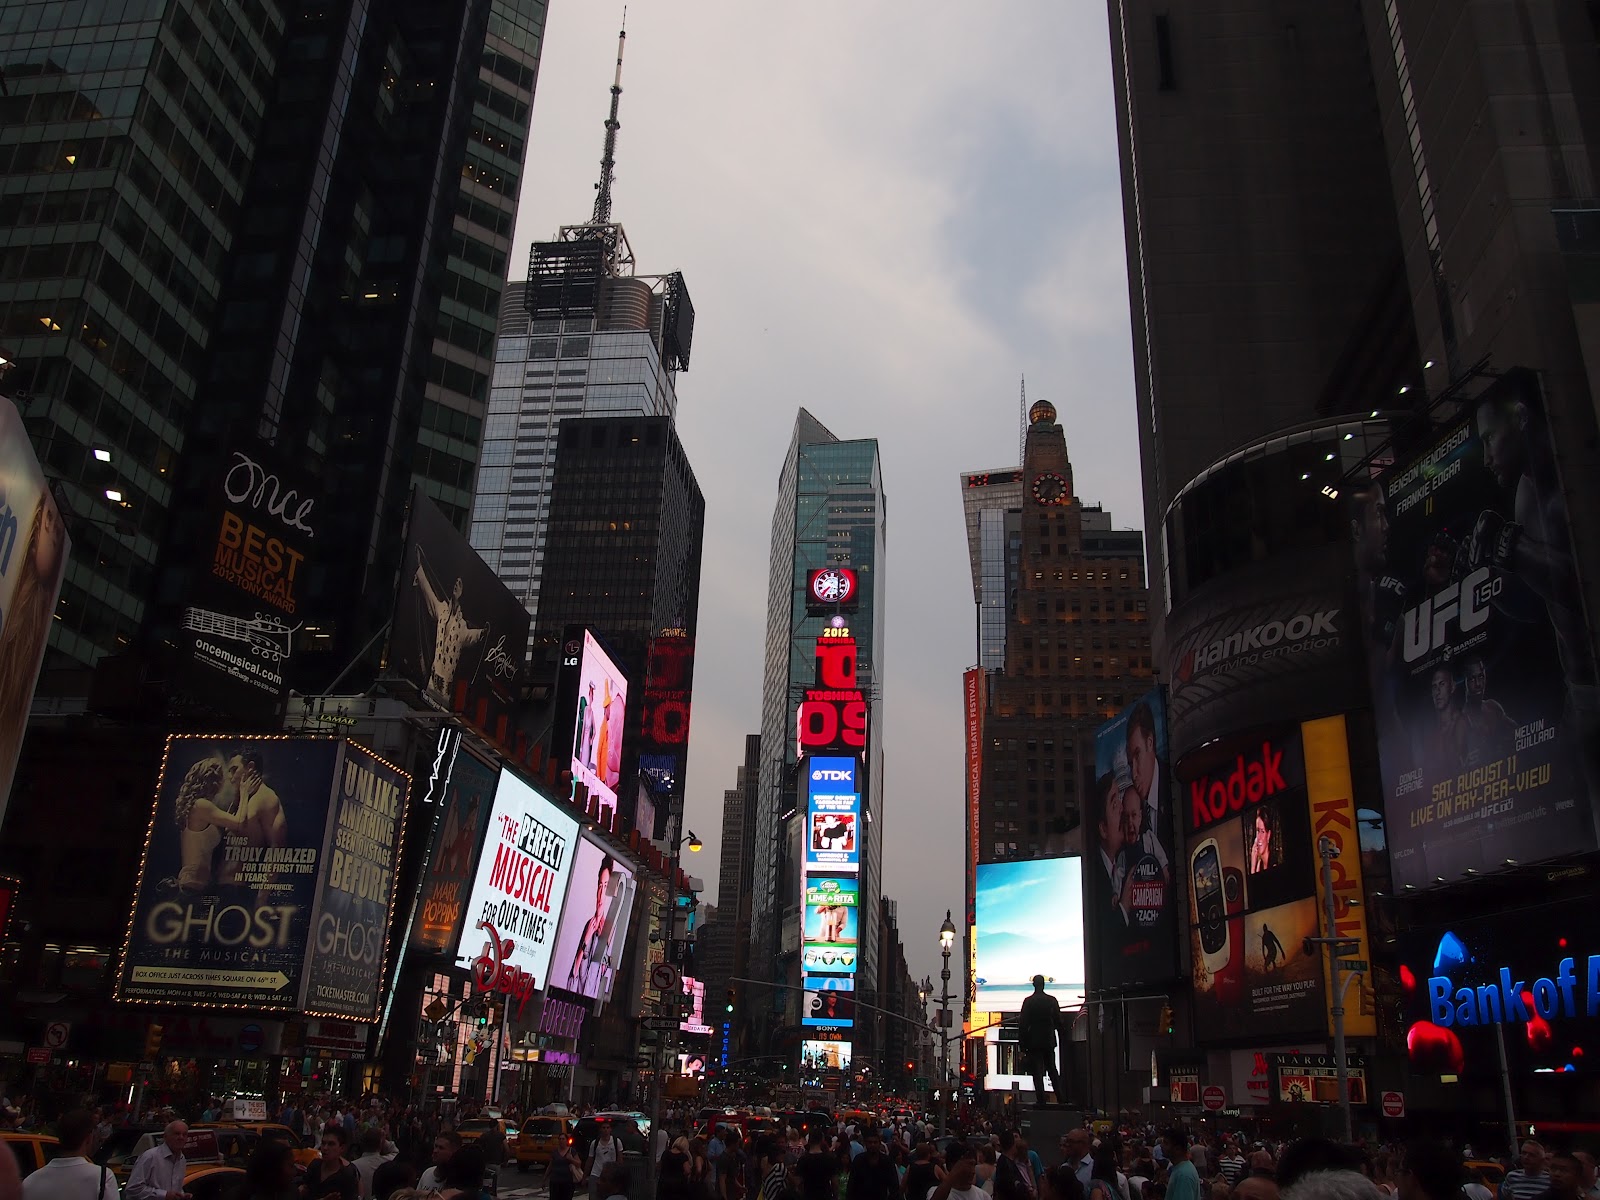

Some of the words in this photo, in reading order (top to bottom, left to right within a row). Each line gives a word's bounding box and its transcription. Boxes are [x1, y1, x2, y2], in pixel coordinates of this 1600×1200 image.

[1388, 464, 1419, 498] BENSON
[1420, 425, 1470, 473] HENDERSON
[1396, 480, 1431, 516] FRANKIE
[1432, 458, 1460, 491] EDGAR
[218, 510, 305, 583] BEST
[214, 543, 297, 604] MUSICAL
[1379, 575, 1406, 596] UFC
[212, 563, 235, 582] 2012
[236, 575, 262, 596] TONY
[262, 590, 296, 614] AWARD
[1403, 566, 1490, 663] UFC
[1475, 576, 1503, 606] 150
[816, 637, 856, 645] TOSHIBA
[824, 628, 850, 638] 2012
[195, 639, 283, 685] oncemusical.com
[563, 657, 579, 666] LG
[1211, 652, 1259, 677] driving
[1261, 636, 1340, 660] emotion
[806, 690, 864, 701] TOSHIBA
[969, 677, 977, 718] FESTIVAL
[319, 714, 355, 725] LAMAR
[1514, 718, 1545, 740] MELVIN
[970, 720, 979, 760] THEATRE
[1515, 727, 1555, 751] GUILLARD
[821, 770, 852, 781] TDK
[971, 763, 980, 804] MUSICAL
[1190, 739, 1289, 829] Kodak
[1399, 767, 1423, 785] DONALD
[1432, 779, 1453, 802] SAT.
[1457, 760, 1504, 794] AUGUST
[1410, 804, 1434, 828] LIVE
[1436, 797, 1452, 819] ON
[1454, 763, 1551, 814] PAY-PER-VIEW
[338, 799, 395, 847] ANYTHING
[225, 847, 263, 862] TRULY
[264, 847, 317, 863] AMAZED
[230, 836, 249, 846] WAS
[336, 828, 357, 853] SEEN
[357, 838, 392, 868] ONSTAGE
[518, 813, 566, 870] PERFECT
[234, 873, 243, 881] IN
[242, 863, 257, 872] FOR
[258, 863, 272, 872] THE
[272, 863, 295, 873] FIRST
[296, 864, 315, 873] TIME
[489, 843, 555, 913] MUSICAL
[1140, 864, 1156, 876] WILL
[433, 880, 460, 902] MARY
[1132, 887, 1163, 907] CAMPAIGN
[146, 901, 299, 947] GHOST
[423, 899, 460, 923] POPPINS
[480, 900, 499, 924] FOR
[498, 899, 520, 933] OUR
[1138, 909, 1156, 921] ZACH
[317, 912, 383, 966] GHOST
[163, 948, 190, 960] THE
[200, 950, 269, 963] MUSICAL
[149, 971, 167, 979] OFFICE
[316, 985, 370, 1004] TICKETMASTER.COM
[1428, 966, 1531, 1028] Bank
[1532, 957, 1577, 1020] of
[539, 996, 586, 1039] FOREVER
[351, 1052, 366, 1060] SONY
